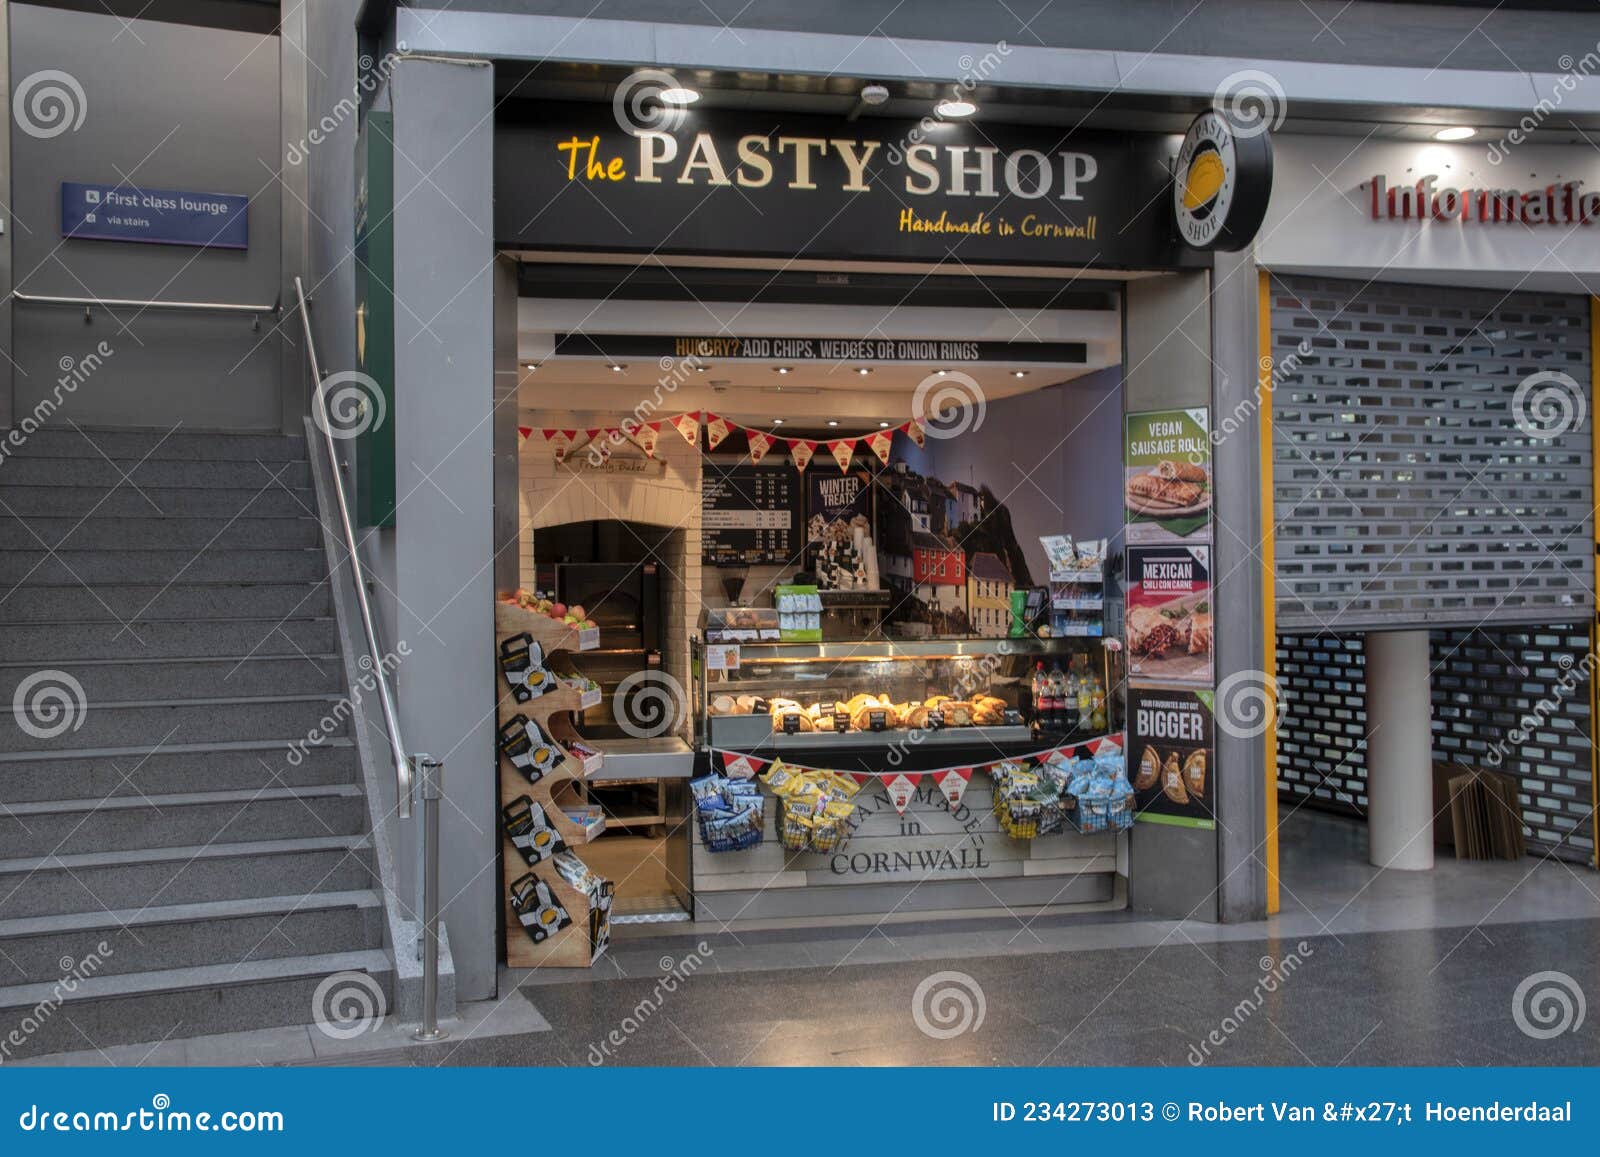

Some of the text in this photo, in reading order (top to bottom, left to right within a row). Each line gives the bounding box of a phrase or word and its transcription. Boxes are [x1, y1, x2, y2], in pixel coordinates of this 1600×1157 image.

[1195, 119, 1230, 150] PASTY
[557, 129, 1099, 201] The PASTY SHOP
[106, 191, 228, 215] First class lounge
[107, 216, 150, 227] via stairs
[900, 207, 1097, 240] Handmade in Cornwall
[1187, 214, 1217, 241] SHOP
[675, 338, 980, 361] HUNGRY? ADD CHIPS, WEDGES OR ONION RINGS
[1149, 421, 1183, 437] VEGAN
[1131, 438, 1176, 456] SAUSAGE
[819, 477, 859, 495] WINTER
[823, 492, 856, 507] TREATS
[1143, 563, 1193, 579] MEXICAN
[1159, 580, 1171, 590] CON
[1171, 580, 1193, 590] CARNE
[1137, 708, 1203, 741] BIGGER
[899, 817, 921, 836] in
[830, 848, 990, 875] CORNWALL
